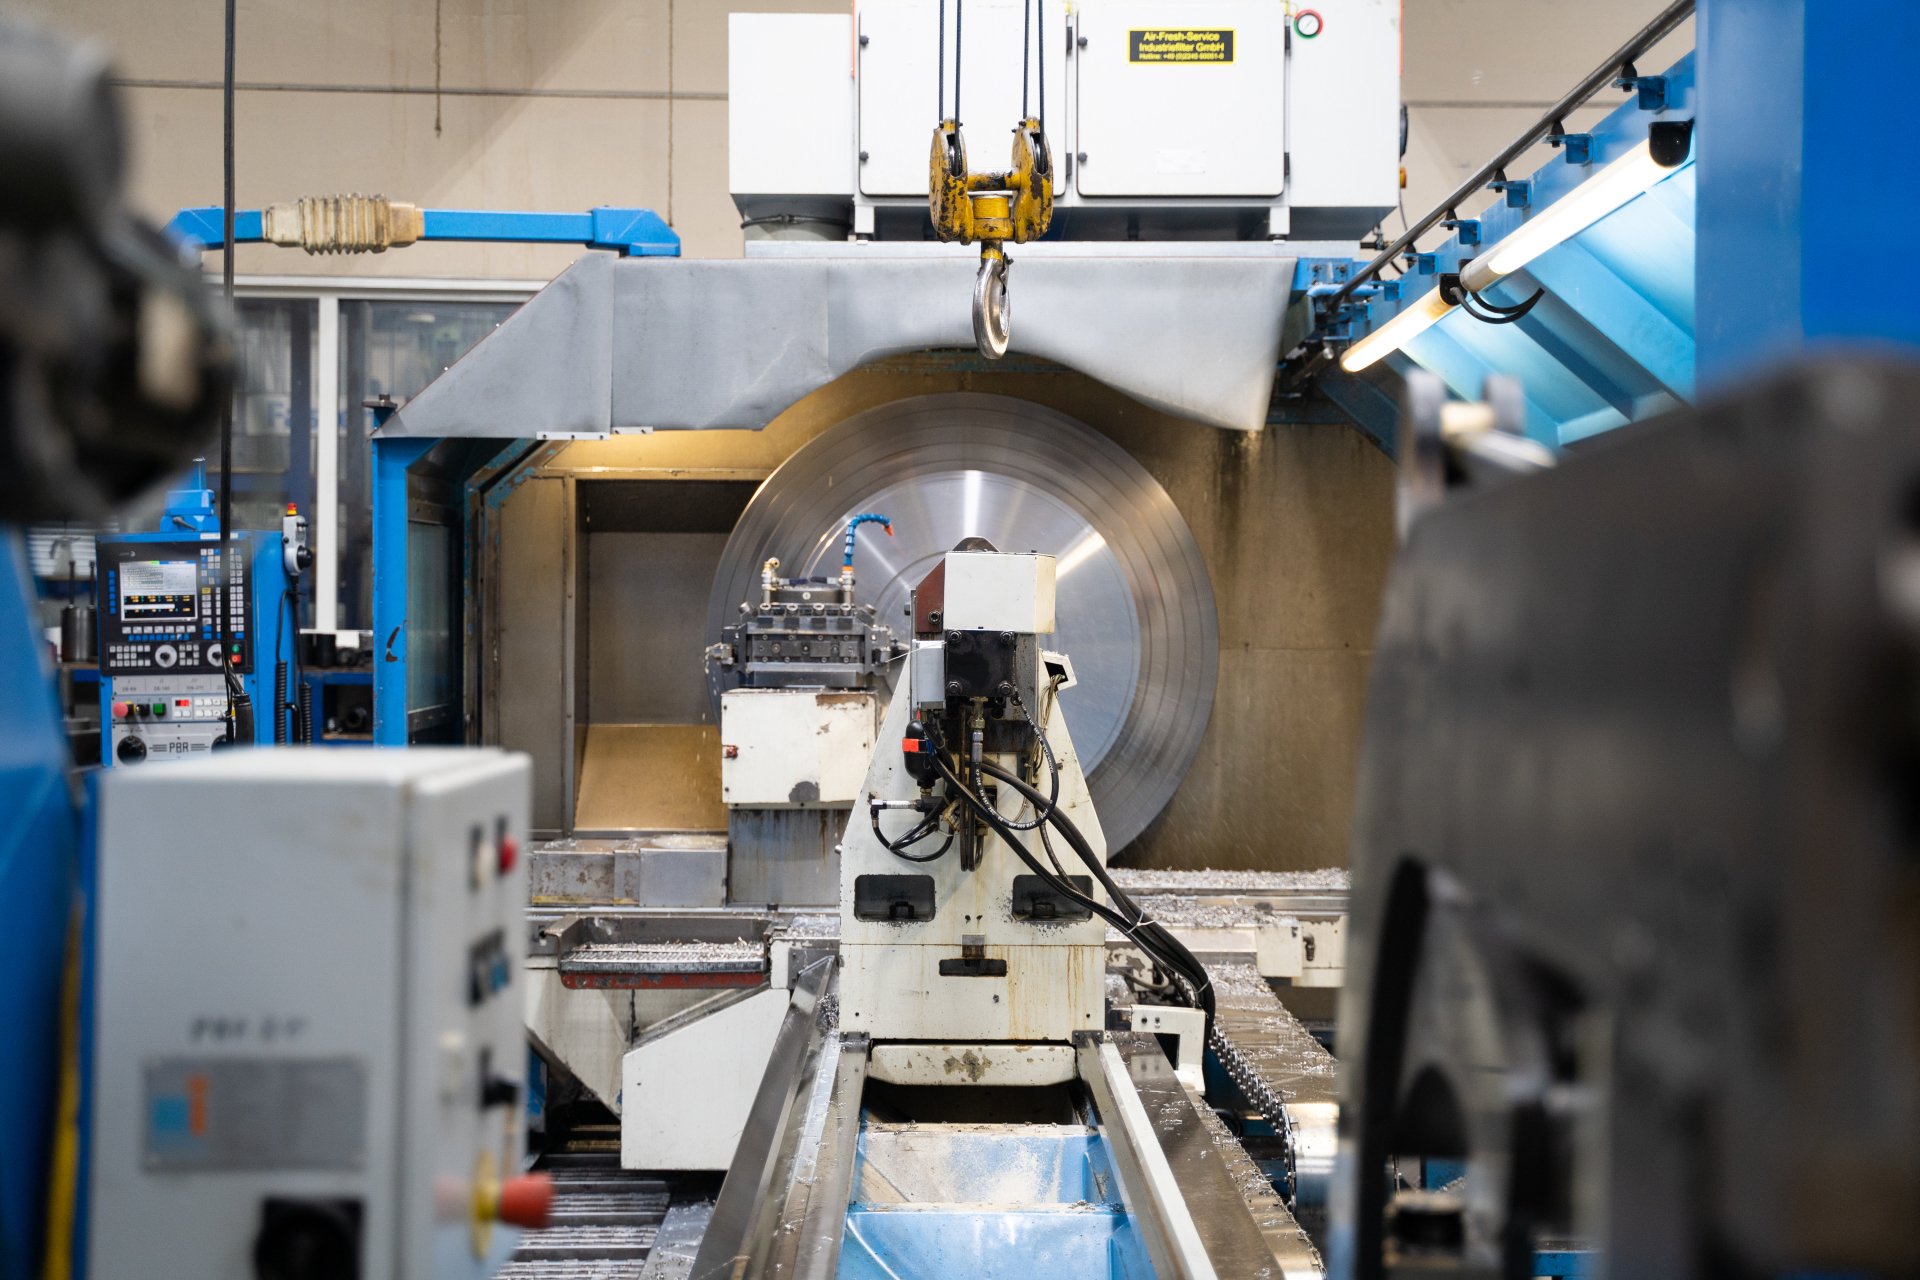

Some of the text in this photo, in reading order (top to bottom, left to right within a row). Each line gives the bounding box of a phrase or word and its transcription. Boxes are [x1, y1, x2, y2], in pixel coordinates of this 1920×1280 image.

[1143, 32, 1220, 41] Air-Fresh-Service
[1139, 42, 1224, 52] Industriefilter GmbH
[169, 742, 189, 753] PBR
